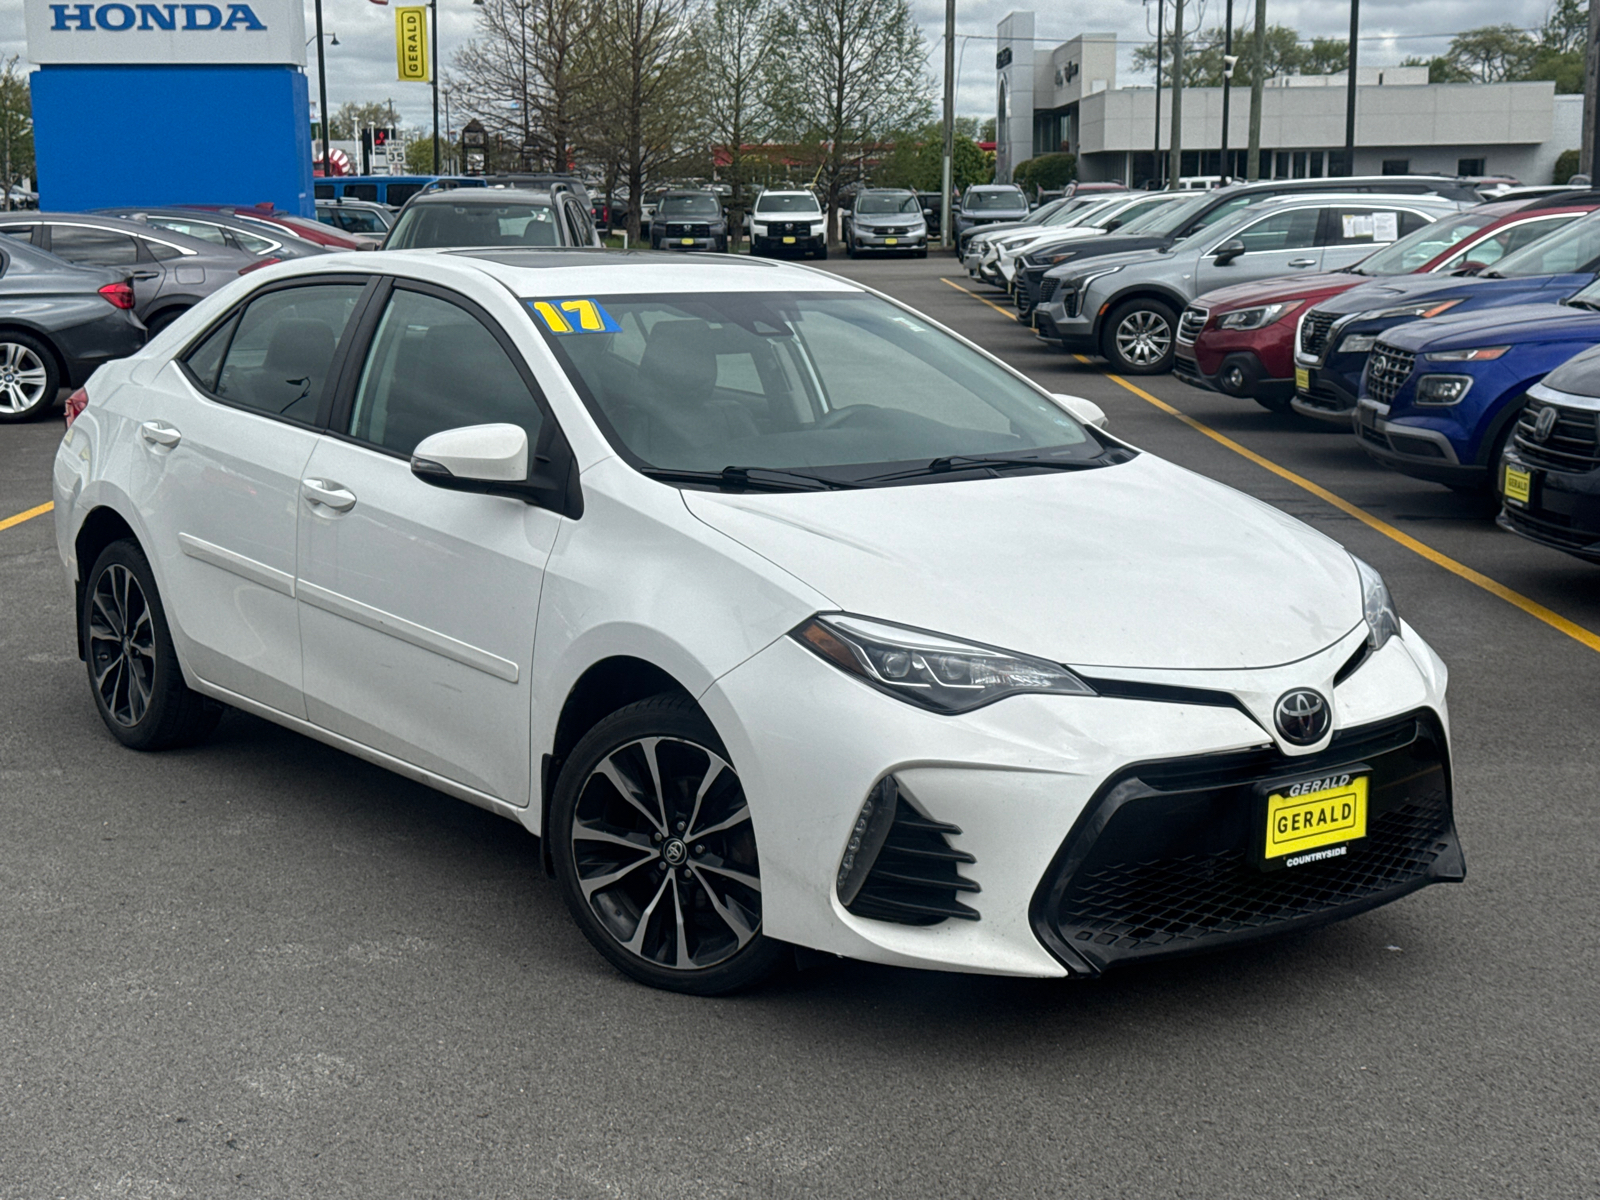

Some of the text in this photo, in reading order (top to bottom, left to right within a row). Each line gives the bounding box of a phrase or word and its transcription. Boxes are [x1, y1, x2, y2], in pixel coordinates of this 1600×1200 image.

[49, 3, 268, 31] HONDA
[407, 16, 418, 72] GERALD
[388, 152, 405, 162] 35
[533, 299, 606, 333] 17
[1508, 477, 1528, 492] GERALD
[1289, 774, 1350, 797] GERALD
[1277, 802, 1352, 834] GERALD
[1286, 846, 1347, 868] COUNTRYSIDE
